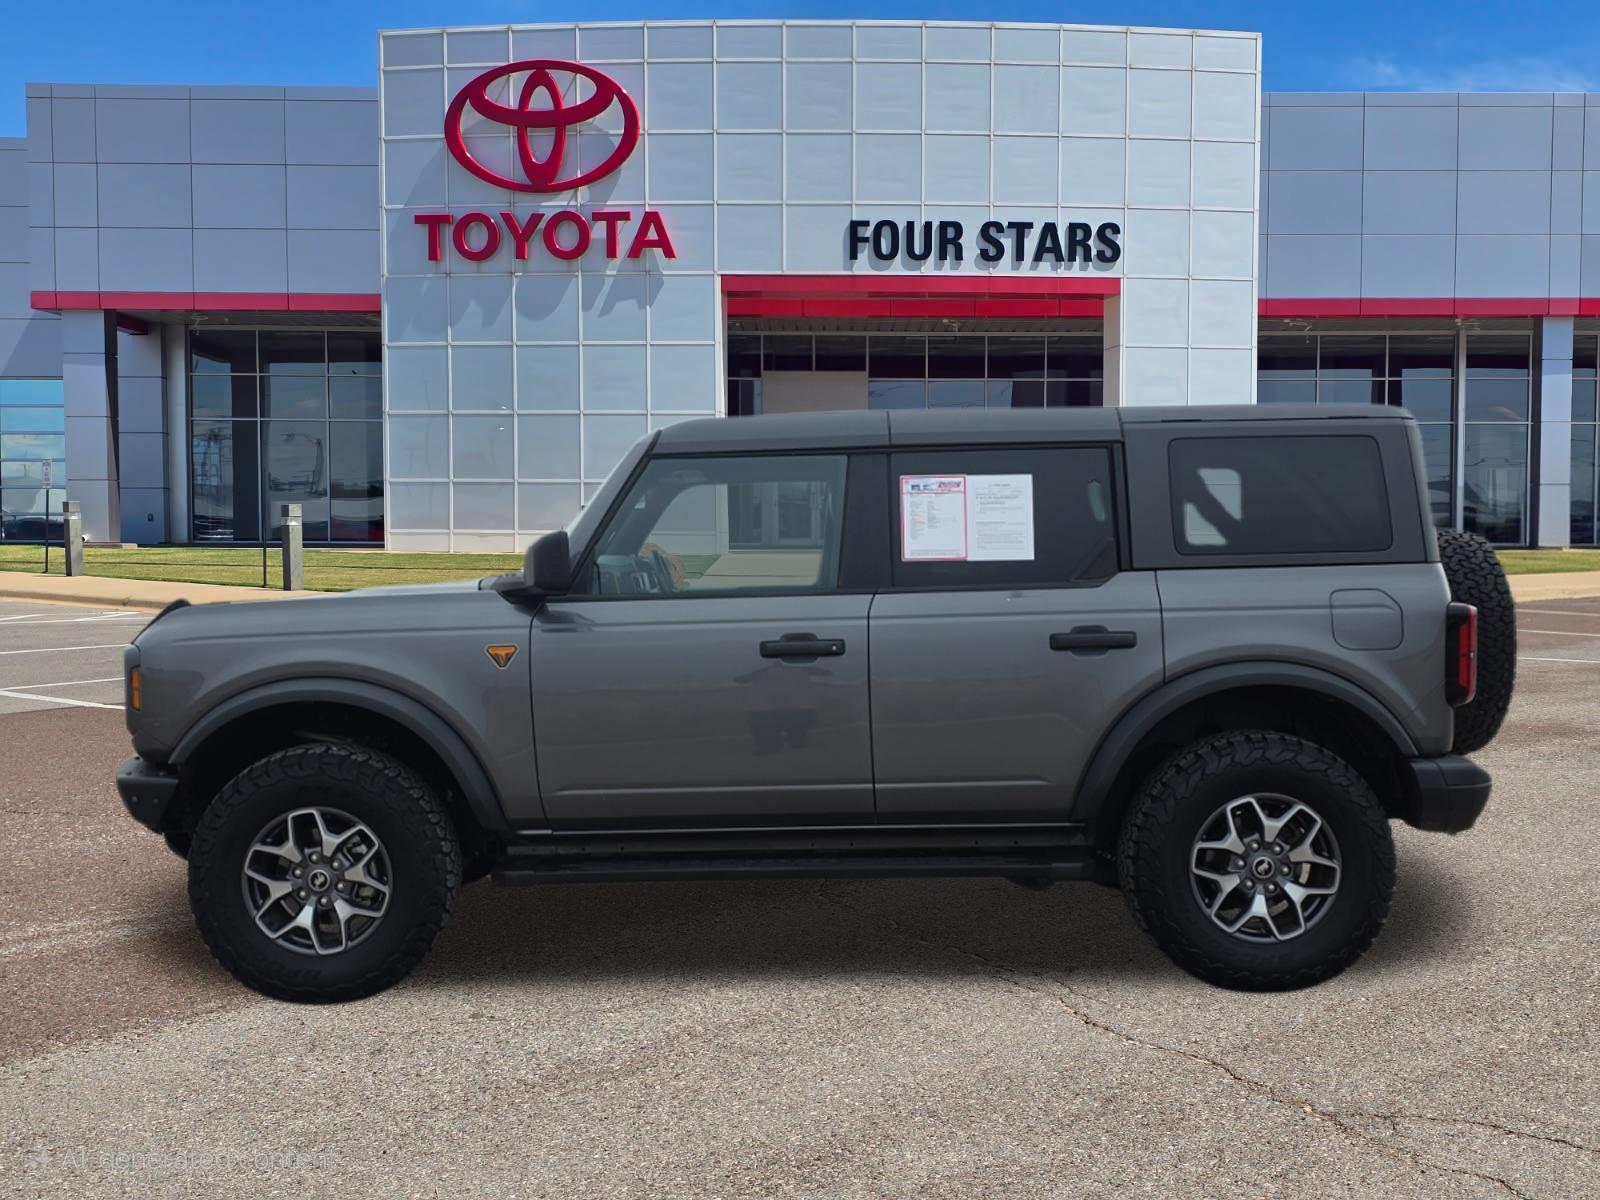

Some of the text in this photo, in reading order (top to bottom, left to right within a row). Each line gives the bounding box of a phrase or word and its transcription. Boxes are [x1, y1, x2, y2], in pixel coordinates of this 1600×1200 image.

[414, 210, 676, 261] TOYOTA
[849, 219, 1121, 263] FOUR STARS
